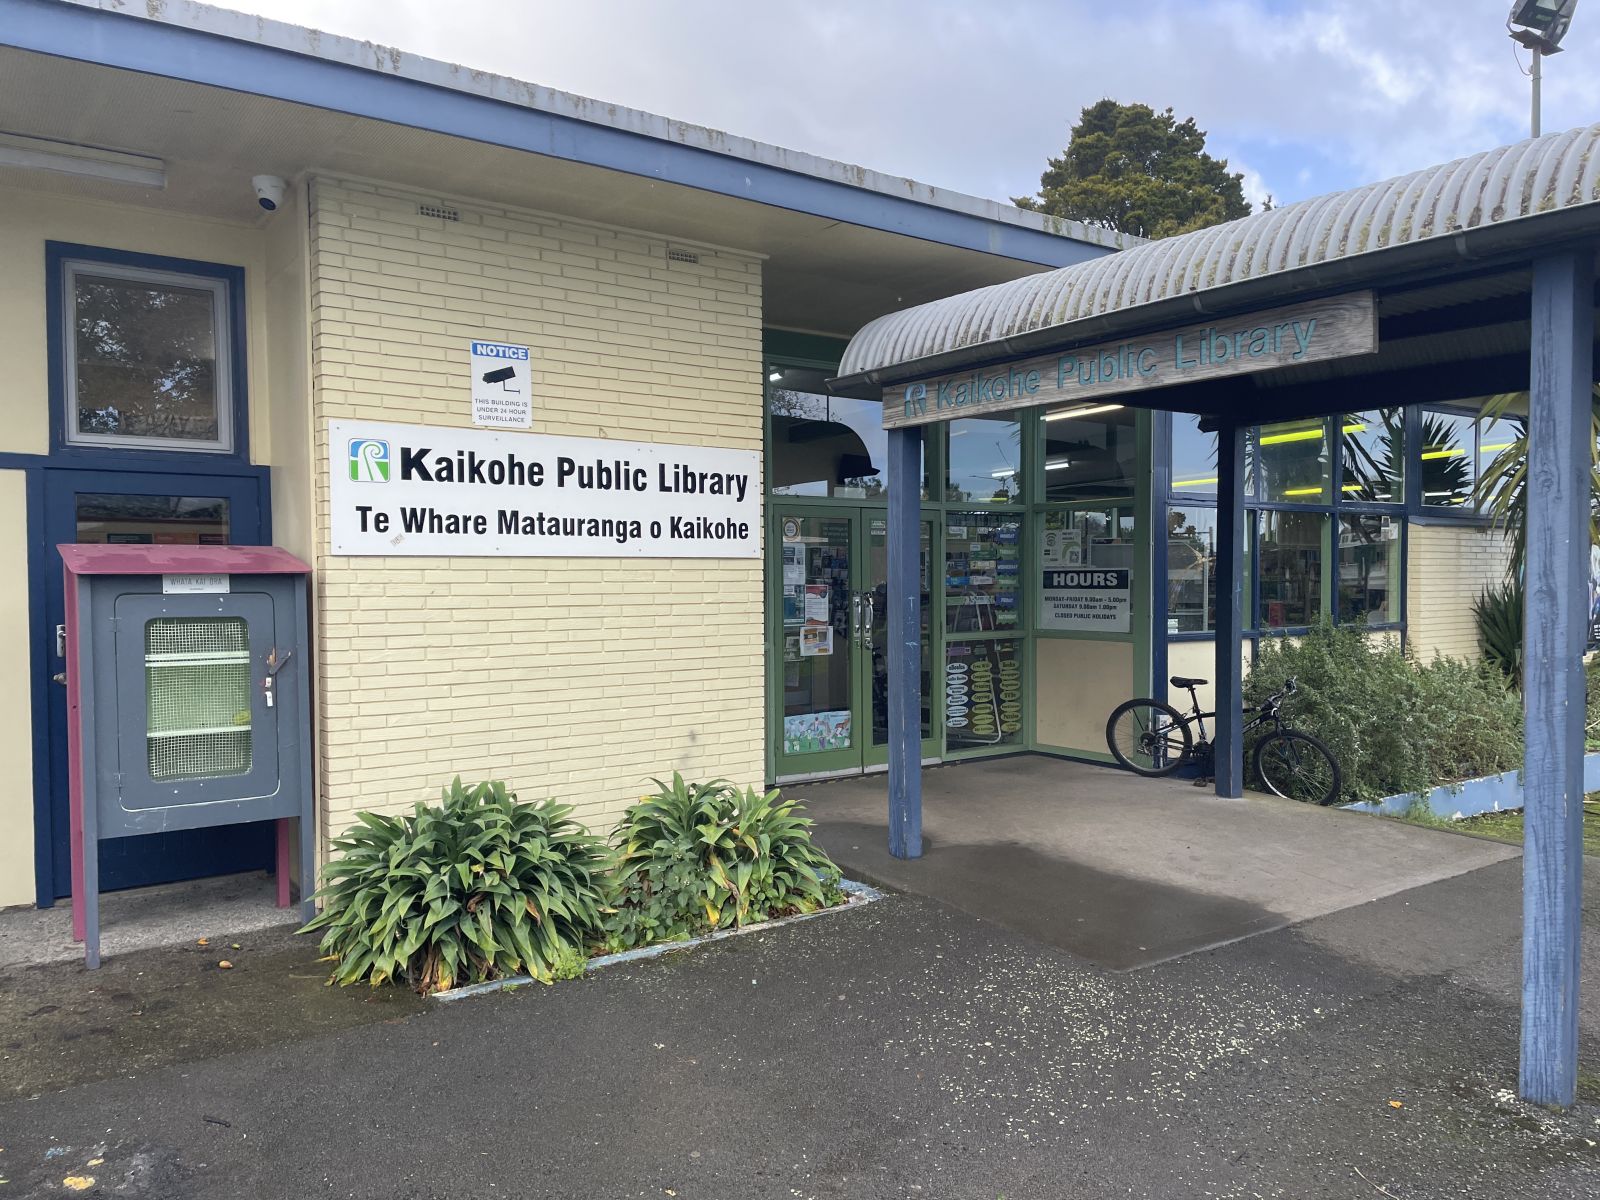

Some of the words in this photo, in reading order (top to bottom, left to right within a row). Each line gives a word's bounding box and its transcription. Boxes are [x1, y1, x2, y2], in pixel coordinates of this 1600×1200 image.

[476, 344, 527, 359] NOTICE
[937, 366, 1041, 410] Kaikohe
[1057, 343, 1158, 389] Public
[1176, 317, 1318, 369] Library
[478, 414, 525, 423] SURVEILLANCE
[400, 446, 544, 487] Kaikohe
[557, 456, 648, 492] Public
[658, 463, 748, 502] Library
[355, 505, 389, 534] Te
[400, 506, 487, 535] Whare
[498, 510, 642, 543] Matauranga
[650, 521, 662, 539] o
[670, 516, 749, 540] Kaikohe
[195, 577, 206, 585] KAI
[209, 577, 222, 586] ORA
[1052, 572, 1118, 587] HOURS
[1107, 596, 1127, 604] 5.00pm
